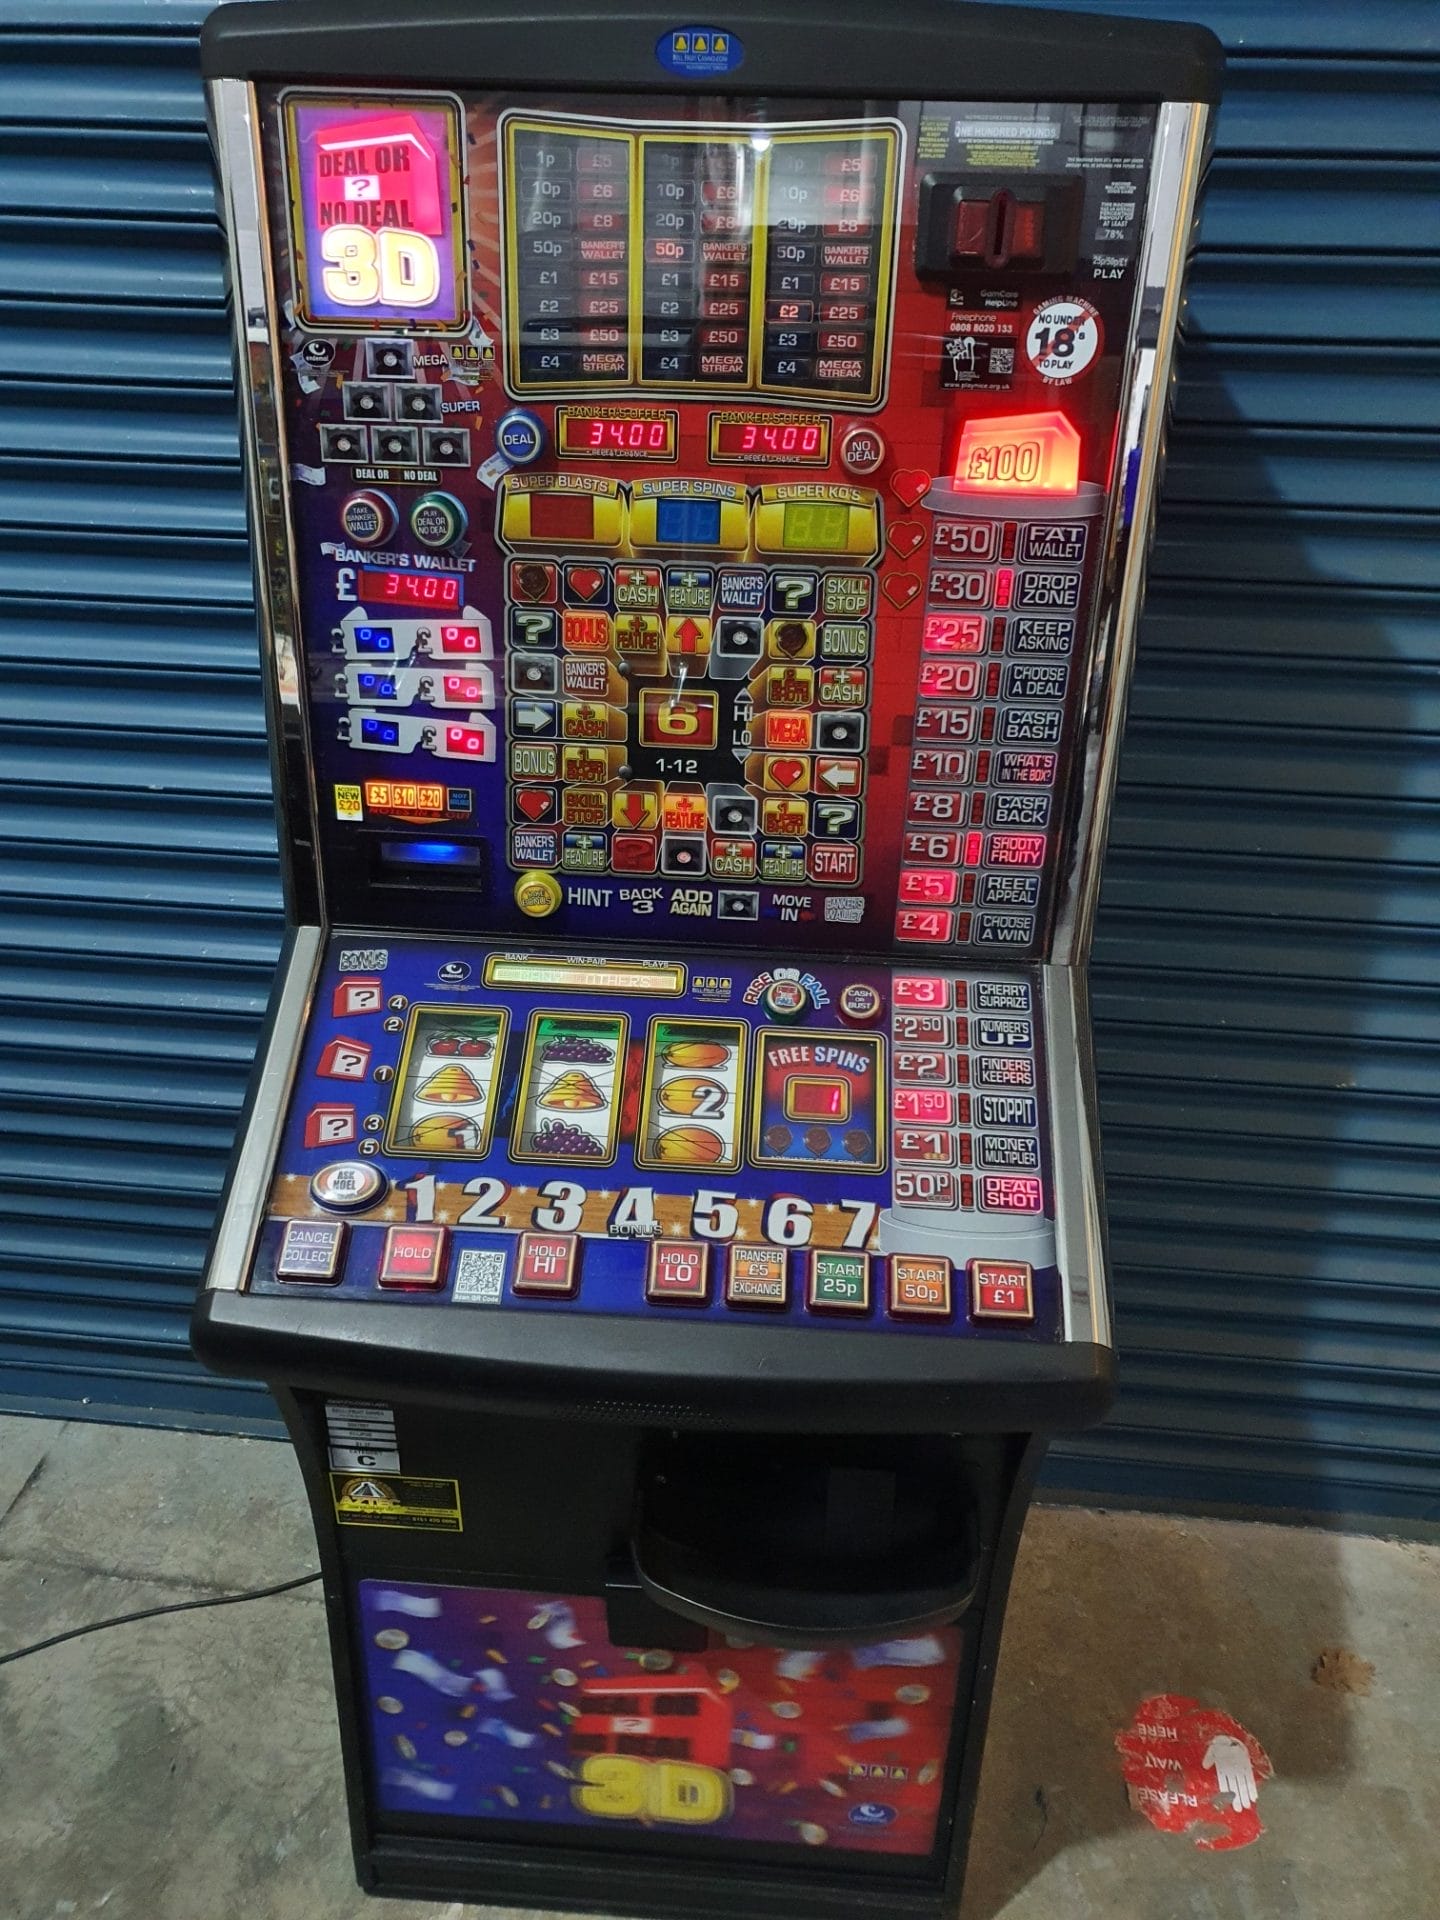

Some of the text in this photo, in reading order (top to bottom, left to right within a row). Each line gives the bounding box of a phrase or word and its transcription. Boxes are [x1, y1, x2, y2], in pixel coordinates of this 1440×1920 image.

[975, 127, 1017, 136] HUNDRED
[319, 145, 410, 177] DEAL OR
[533, 181, 560, 197] 10p
[320, 200, 413, 227] NO DEAL
[1105, 230, 1124, 239] 78%
[655, 242, 684, 257] 50p
[322, 225, 440, 306] 3D
[588, 272, 617, 285] £15
[1094, 269, 1124, 279] PLAY
[981, 290, 1018, 298] GamCare
[540, 300, 558, 313] £2
[589, 301, 618, 313] £25
[779, 305, 798, 318] £2
[1033, 296, 1099, 317] GAMING MACHINE
[952, 313, 996, 322] Freephone
[1039, 315, 1085, 325] NO UNDER
[589, 329, 618, 341] £50
[950, 324, 971, 332] 0808
[998, 325, 1012, 333] 133
[413, 355, 448, 366] MEGA
[819, 360, 861, 369] MEGA
[1039, 359, 1074, 369] TO PLAY
[819, 368, 861, 377] STREAK
[1055, 377, 1072, 386] LAW
[441, 401, 480, 413] SUPER
[630, 408, 667, 419] OFFER
[783, 414, 821, 425] OFFER
[504, 433, 534, 445] DEAL
[590, 423, 664, 447] 34.00
[743, 426, 818, 450] 34.00
[847, 450, 878, 462] DEAL
[967, 442, 1041, 482] £100
[356, 469, 437, 481] DEAL OR NO DEAL
[642, 481, 736, 497] SUPER SPINS
[934, 525, 990, 553] £50
[1029, 527, 1083, 541] FAT
[1029, 542, 1081, 558] WALLET
[335, 550, 477, 572] BANKER'S WALLET
[336, 568, 357, 601] £
[827, 579, 866, 595] SKILL
[930, 573, 985, 600] £30
[1025, 574, 1078, 589] DROP
[618, 587, 658, 603] CASH
[721, 591, 762, 605] WALLET
[1022, 590, 1076, 605] ZONE
[827, 596, 866, 611] STOP
[565, 618, 607, 645] BONUS
[925, 619, 979, 646] £25
[1019, 621, 1072, 636] KEEP
[823, 629, 866, 654] BONUS
[1017, 636, 1069, 650] ASKING
[921, 667, 975, 692] £20
[1013, 666, 1065, 682] CHOOSE
[565, 678, 606, 690] WALLET
[821, 685, 862, 701] CASH
[734, 706, 753, 722] HI
[1008, 711, 1060, 725] CASH
[917, 709, 970, 734] £15
[732, 730, 751, 746] LO
[768, 718, 808, 745] MEGA
[1006, 726, 1058, 739] BASH
[515, 751, 555, 774] BONUS
[656, 758, 698, 774] 1-12
[913, 752, 964, 777] £10
[1003, 753, 1053, 767] WHAT'S
[338, 792, 359, 800] NEW
[371, 786, 387, 804] £5
[394, 789, 414, 805] £10
[914, 794, 954, 818] £8
[997, 797, 1047, 810] CASH
[996, 810, 1045, 824] BACK
[910, 835, 949, 858] £6
[515, 850, 554, 861] WALLET
[814, 852, 855, 873] START
[990, 851, 1040, 864] FRUITY
[715, 857, 751, 871] CASH
[906, 875, 944, 897] £5
[987, 877, 1036, 890] REEL
[568, 887, 613, 908] HINT
[619, 888, 664, 901] BACK
[671, 888, 714, 904] ADD
[772, 894, 811, 908] MOVE
[986, 890, 1034, 903] APPEAL
[670, 903, 712, 916] AGAIN
[781, 909, 798, 921] IN
[902, 913, 940, 936] £4
[983, 915, 1032, 929] CHOOSE
[743, 972, 774, 1005] RISE
[773, 968, 800, 981] OR
[799, 973, 830, 1009] FALL
[897, 981, 934, 1002] £3
[979, 983, 1027, 996] CHERRY
[979, 995, 1028, 1009] SURPRIZE
[981, 1033, 1030, 1045] UP
[768, 1046, 870, 1074] FREE SPINS
[898, 1055, 938, 1078] £2
[982, 1058, 1031, 1071] FINDERS
[982, 1071, 1032, 1085] KEEPERS
[983, 1099, 1033, 1124] STOPPIT
[901, 1132, 942, 1154] £1
[985, 1136, 1035, 1151] MONEY
[337, 1170, 355, 1180] ASK
[333, 1179, 356, 1190] NOEL
[896, 1173, 949, 1196] 50p
[986, 1179, 1039, 1193] DEAL
[405, 1174, 587, 1232] 1 2 3
[986, 1193, 1038, 1207] SHOT
[693, 1190, 880, 1248] 5 6 7
[288, 1230, 335, 1244] CANCEL
[284, 1248, 333, 1263] COLLECT
[393, 1247, 432, 1258] HOLD
[528, 1245, 566, 1258] HOLD
[735, 1250, 783, 1263] TRANSFER
[533, 1257, 556, 1273] HI
[660, 1253, 698, 1265] HOLD
[664, 1265, 692, 1282] LO
[747, 1264, 769, 1277] £5
[817, 1262, 864, 1276] START
[898, 1269, 945, 1282] START
[979, 1273, 1026, 1287] START
[734, 1282, 781, 1296] EXCHANGE
[823, 1278, 857, 1297] 25p
[905, 1284, 938, 1302] 50p
[992, 1290, 1014, 1304] £1
[357, 1456, 376, 1466] C
[1137, 1723, 1177, 1742] HERE
[1145, 1751, 1182, 1771] WAIT
[573, 1754, 732, 1823] 3D
